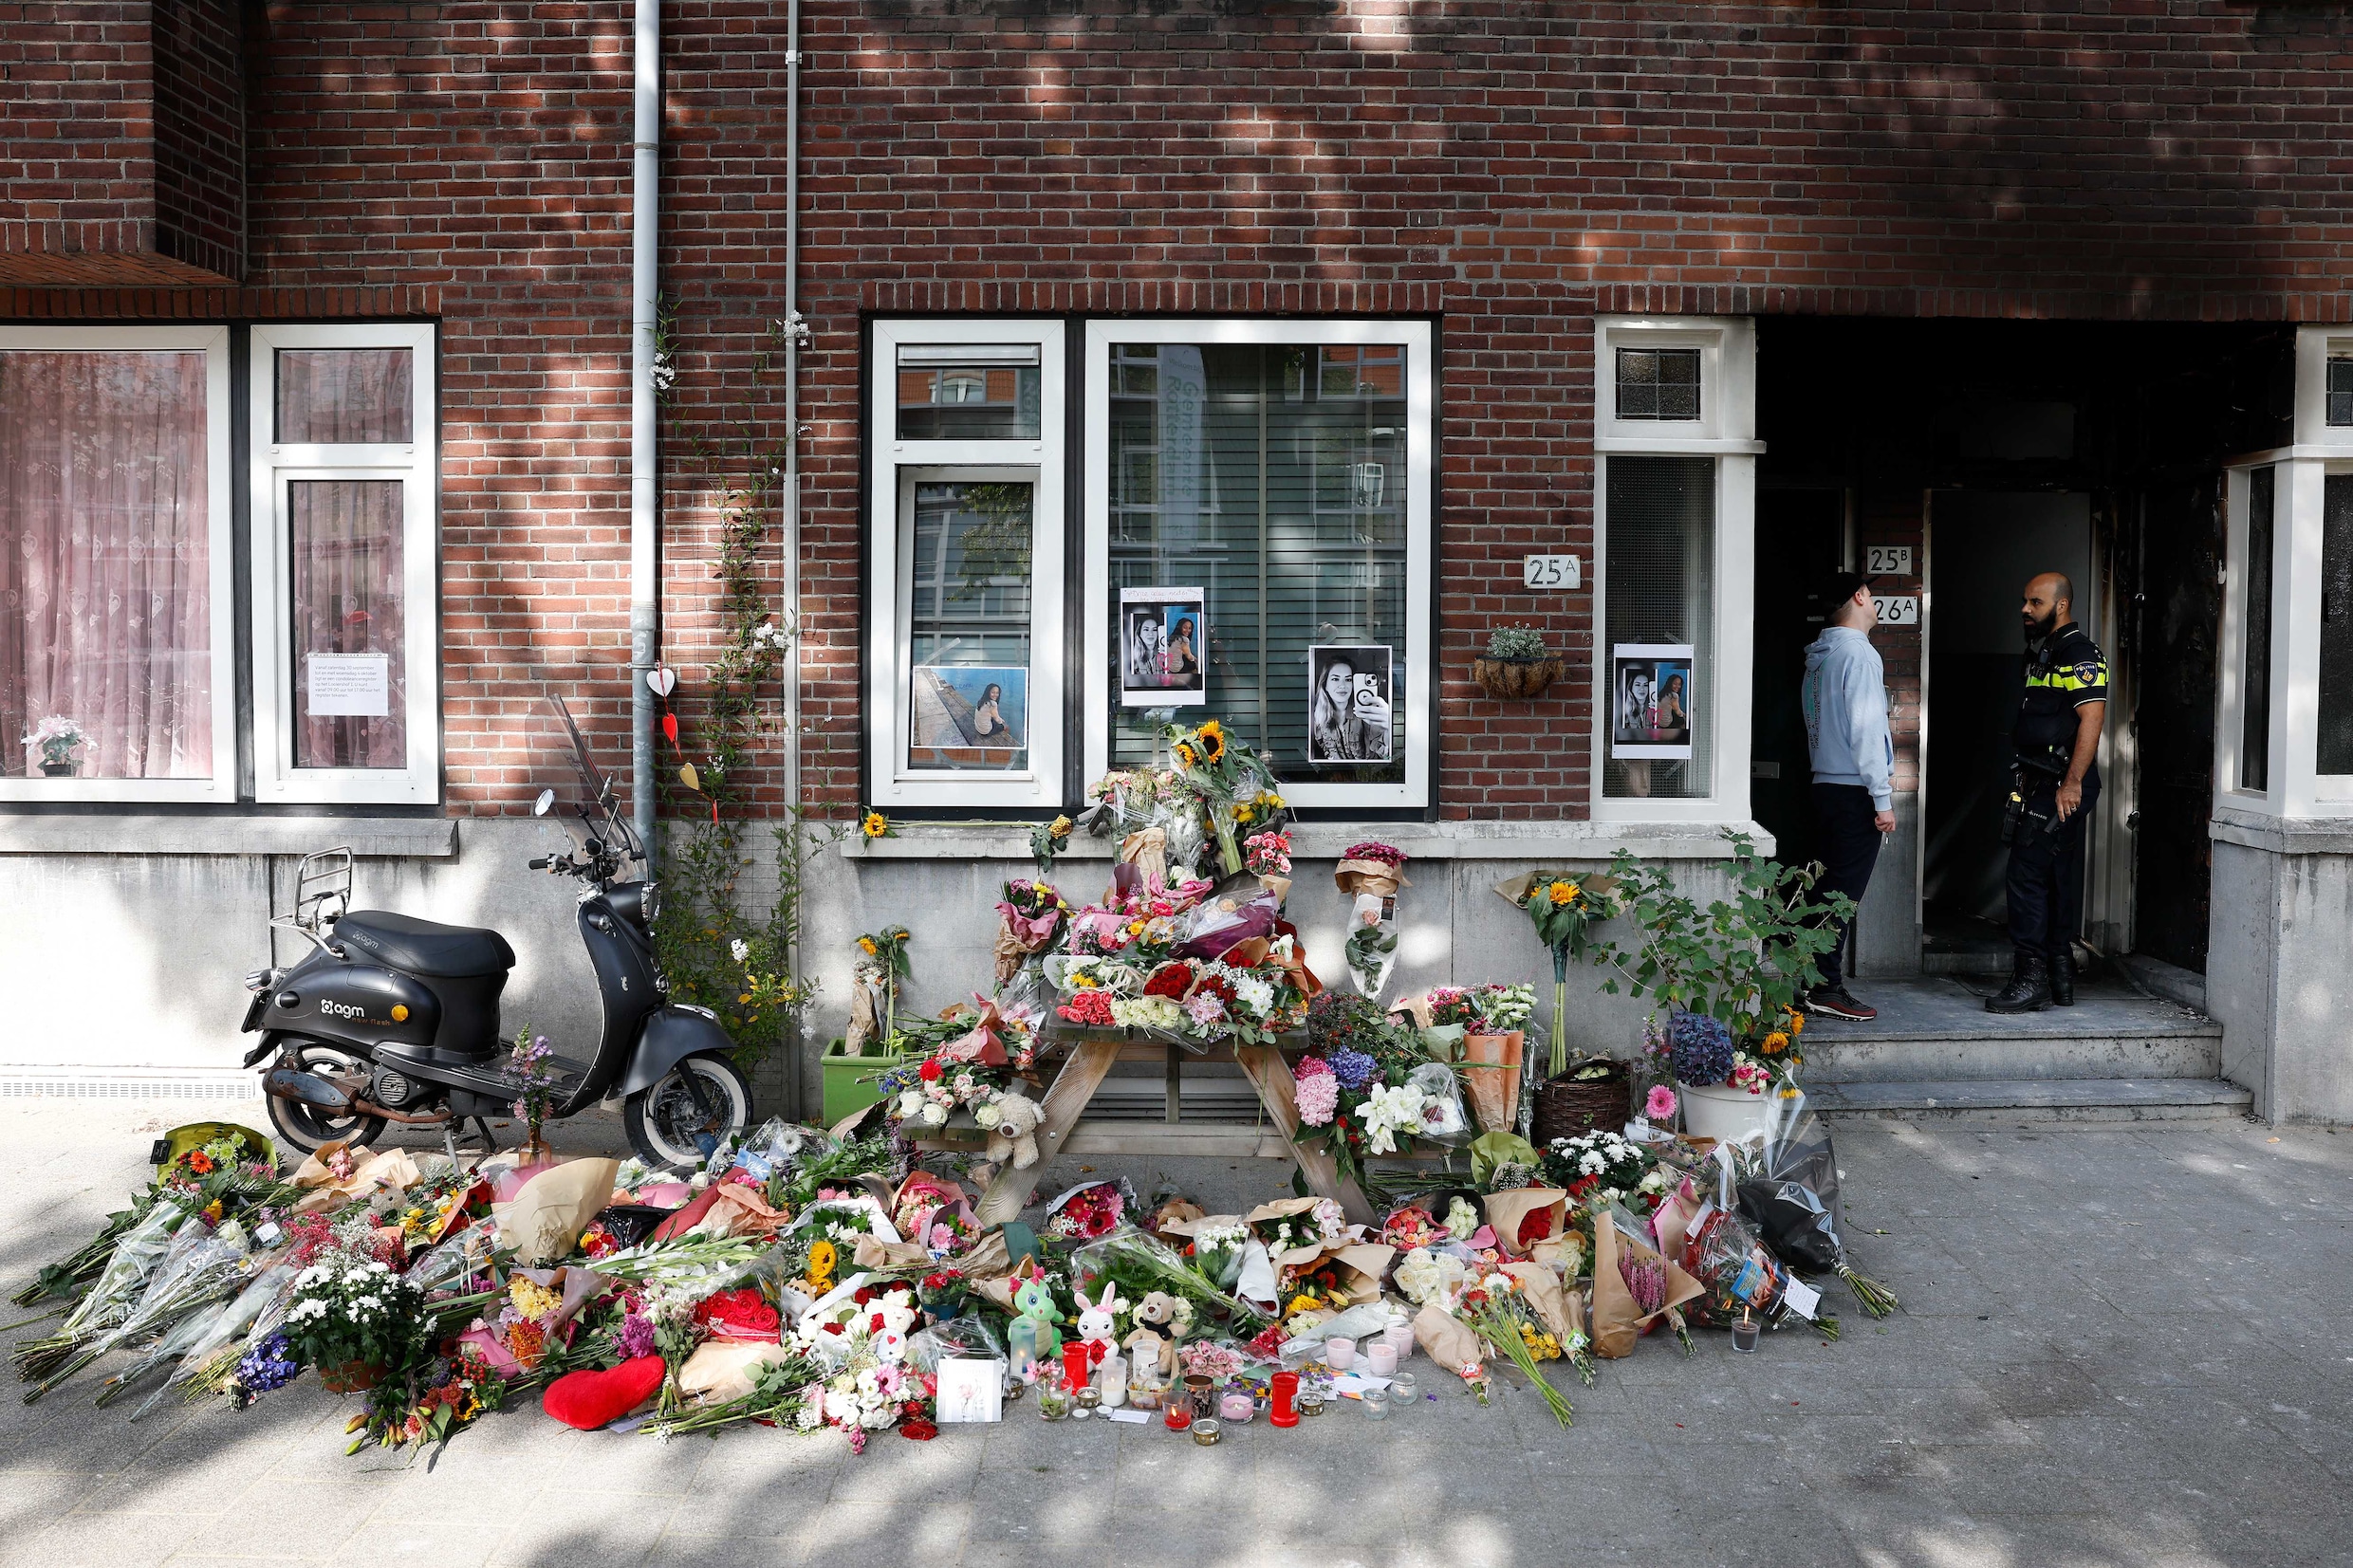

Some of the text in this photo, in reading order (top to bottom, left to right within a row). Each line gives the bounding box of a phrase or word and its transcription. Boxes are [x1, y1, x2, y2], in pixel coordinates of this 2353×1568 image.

[1166, 376, 1182, 496] Rotterdam
[1182, 381, 1199, 497] Gemeente
[1529, 559, 1576, 584] 25A
[1871, 548, 1907, 571] 25B
[361, 935, 379, 950] agm
[334, 1004, 364, 1019] agm
